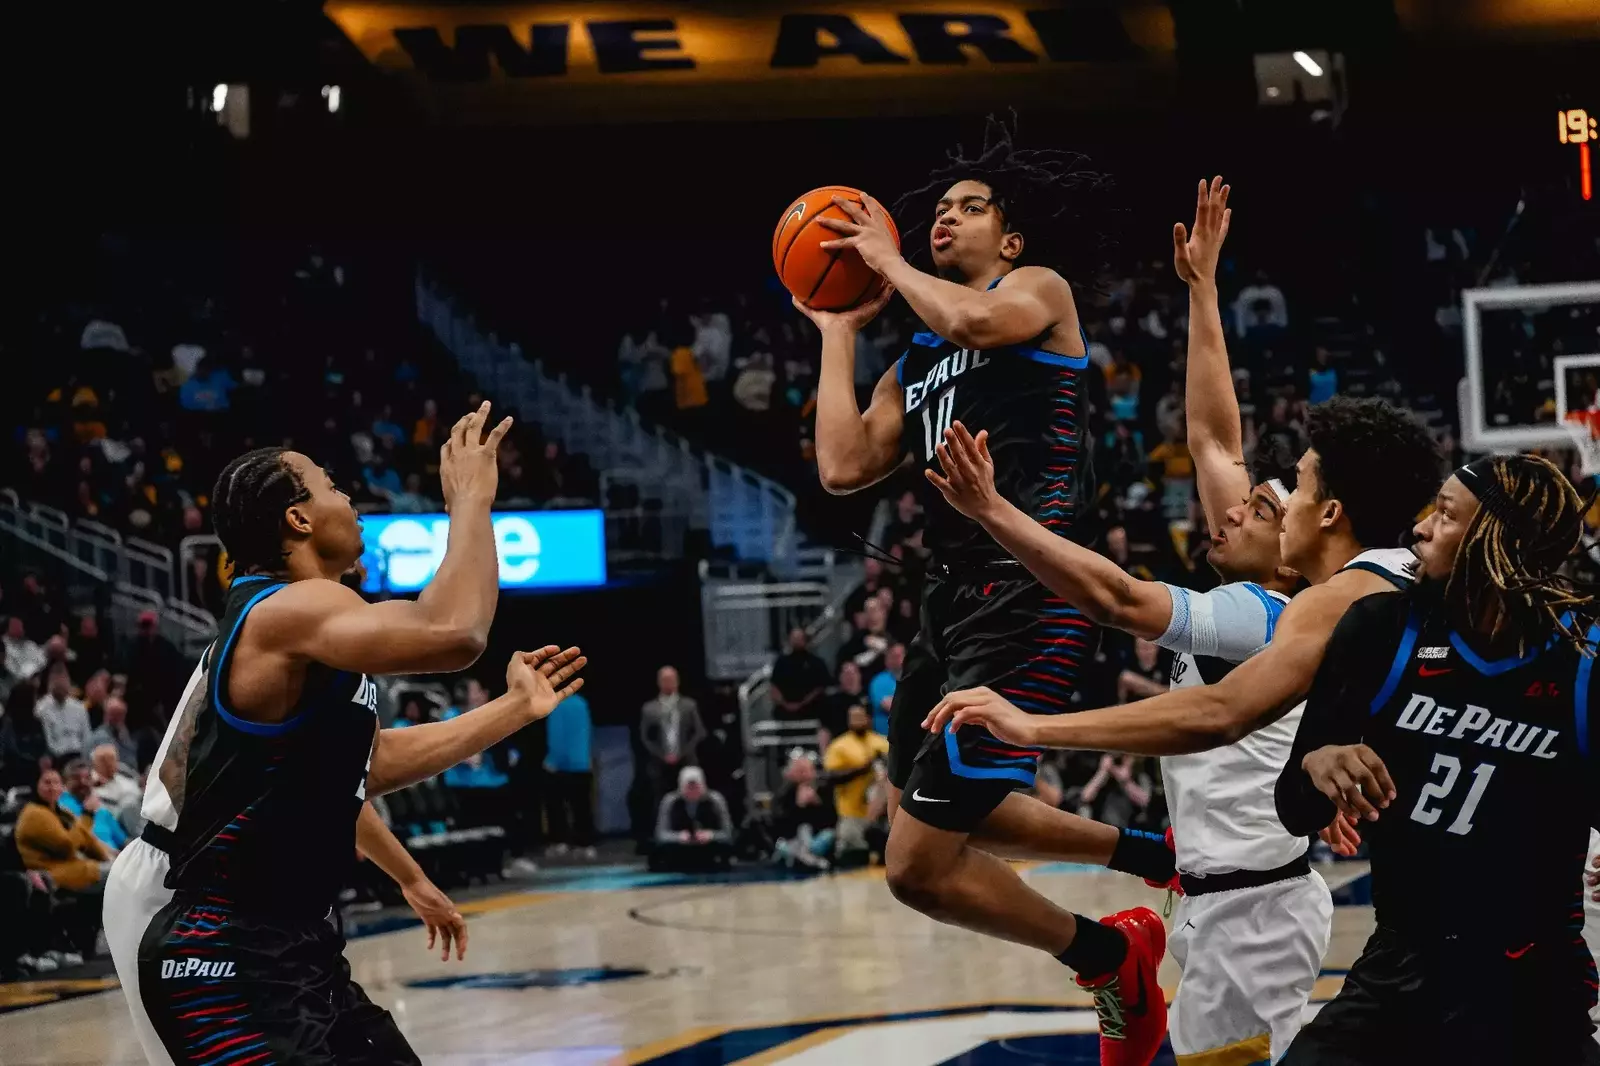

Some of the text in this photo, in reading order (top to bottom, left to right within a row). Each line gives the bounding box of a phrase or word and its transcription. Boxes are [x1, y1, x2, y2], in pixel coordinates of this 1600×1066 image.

[393, 13, 1110, 80] WE AR
[905, 348, 990, 414] EPAUL
[1410, 752, 1497, 836] 21
